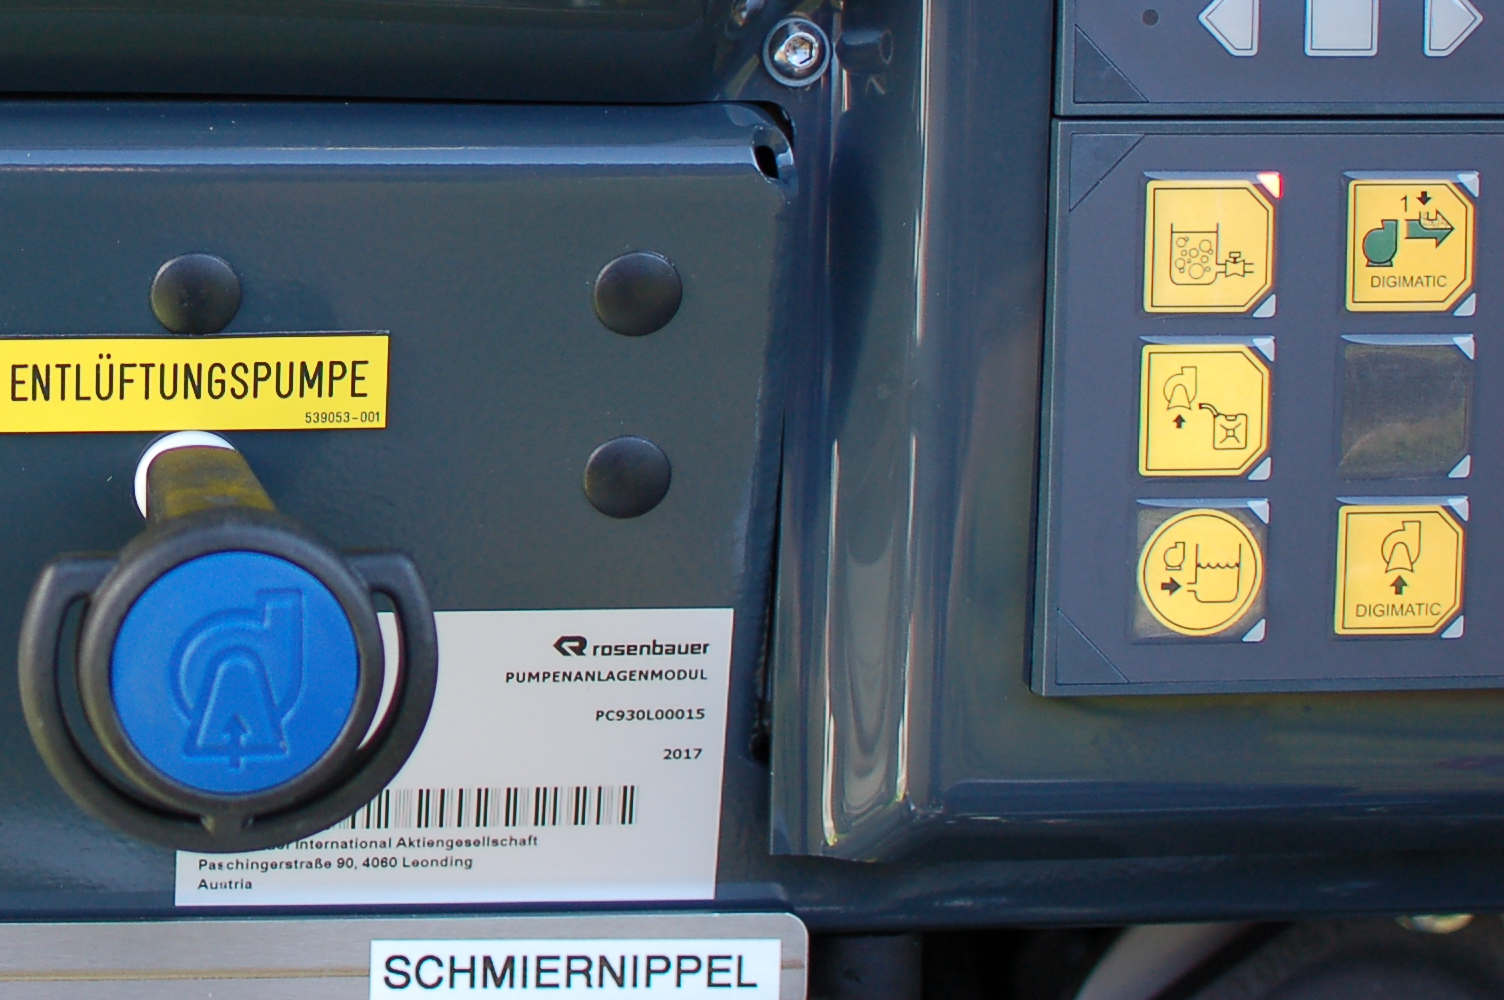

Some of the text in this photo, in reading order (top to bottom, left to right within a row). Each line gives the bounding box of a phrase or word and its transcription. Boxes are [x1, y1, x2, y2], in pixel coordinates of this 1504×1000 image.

[1401, 194, 1408, 212] 1
[1370, 275, 1447, 289] DIGIMATIC
[11, 353, 369, 401] ENTLÜFTUNGSPUMPE
[305, 411, 380, 424] 539053-001
[1355, 603, 1442, 619] DIGIMATIC
[592, 639, 710, 657] rosenbauer
[505, 669, 708, 684] PUMPENANLAGENMODUL
[595, 707, 706, 723] PC930L00015
[664, 747, 703, 761] 2017
[396, 834, 538, 852] Aktiengesellschaft
[198, 856, 332, 873] Paschingerstraße
[336, 856, 358, 871] 90,
[402, 854, 474, 872] Leonding
[198, 878, 253, 892] Austria
[383, 954, 758, 989] SCHMIERNIPPEL
